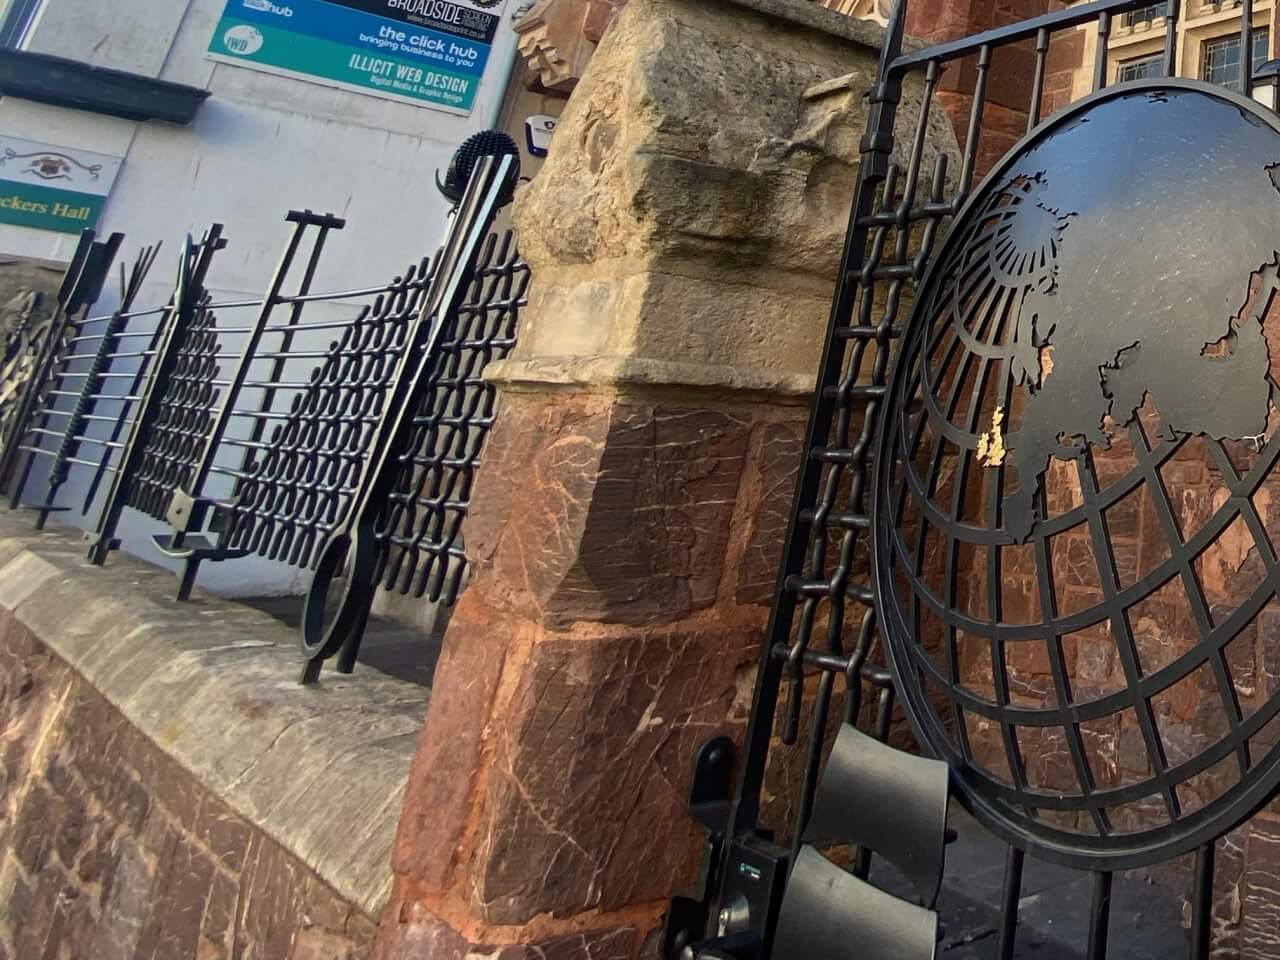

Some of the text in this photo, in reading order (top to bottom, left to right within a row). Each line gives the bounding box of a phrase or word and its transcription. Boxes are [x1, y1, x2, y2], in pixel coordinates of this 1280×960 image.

[359, 33, 475, 69] bringing business to you
[379, 25, 478, 60] the click hub
[349, 53, 469, 94] ILLICIT WEB DESIGN
[0, 195, 91, 220] ckers Hall
